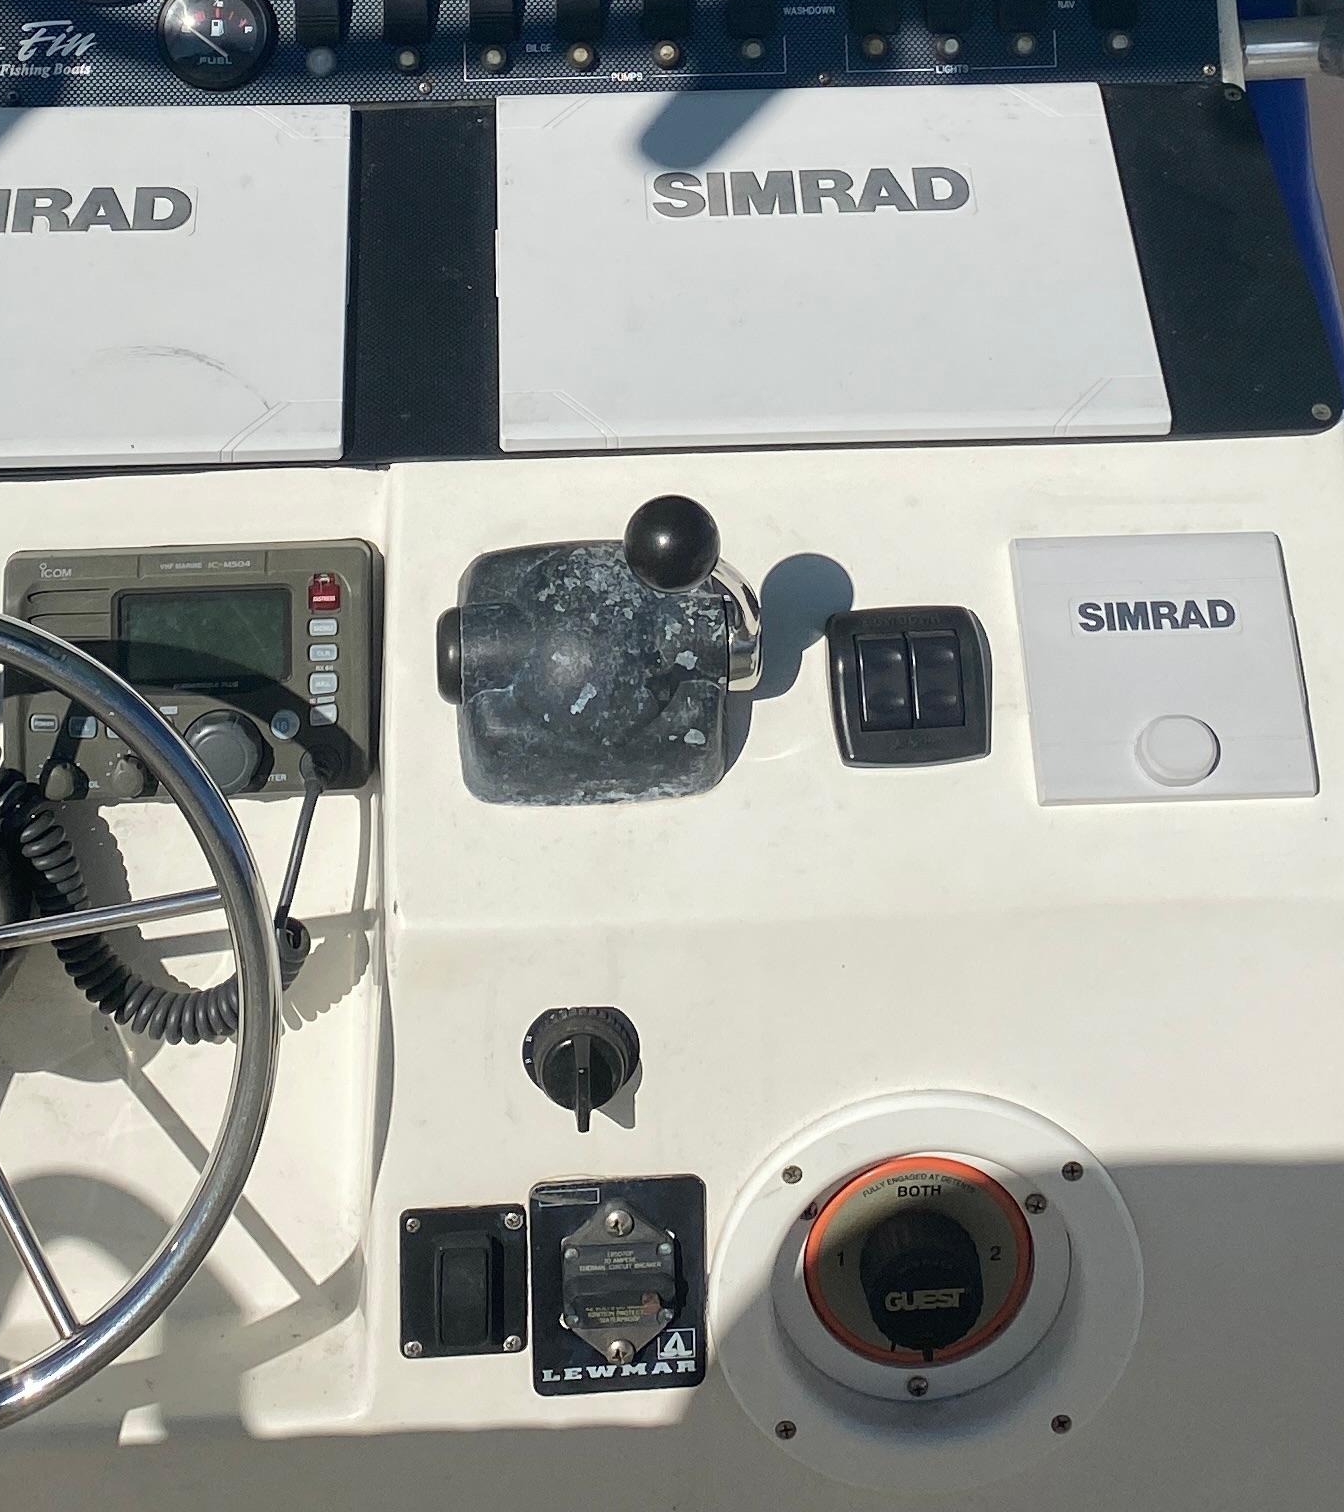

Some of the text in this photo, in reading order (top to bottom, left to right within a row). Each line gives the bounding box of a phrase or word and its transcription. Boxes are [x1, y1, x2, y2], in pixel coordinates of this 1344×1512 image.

[782, 5, 836, 16] WASHDOWN
[16, 19, 99, 62] Fin
[525, 43, 552, 53] BILGE
[199, 56, 233, 65] FUEL
[0, 63, 52, 79] Fishing
[53, 62, 92, 76] Boats
[611, 71, 644, 82] PUMPS
[936, 64, 969, 74] LIGHTS
[652, 166, 970, 218] SIMRAD
[207, 559, 251, 569] IC-M504
[1077, 599, 1236, 633] SIMRAD
[862, 1172, 976, 1198] FULLY ENGAGED AT DETENTS
[897, 1184, 942, 1198] BOTH
[837, 1250, 845, 1267] 1
[989, 1245, 1002, 1261] 2
[884, 1287, 966, 1312] GUEST
[542, 1359, 697, 1383] LEWMAR
